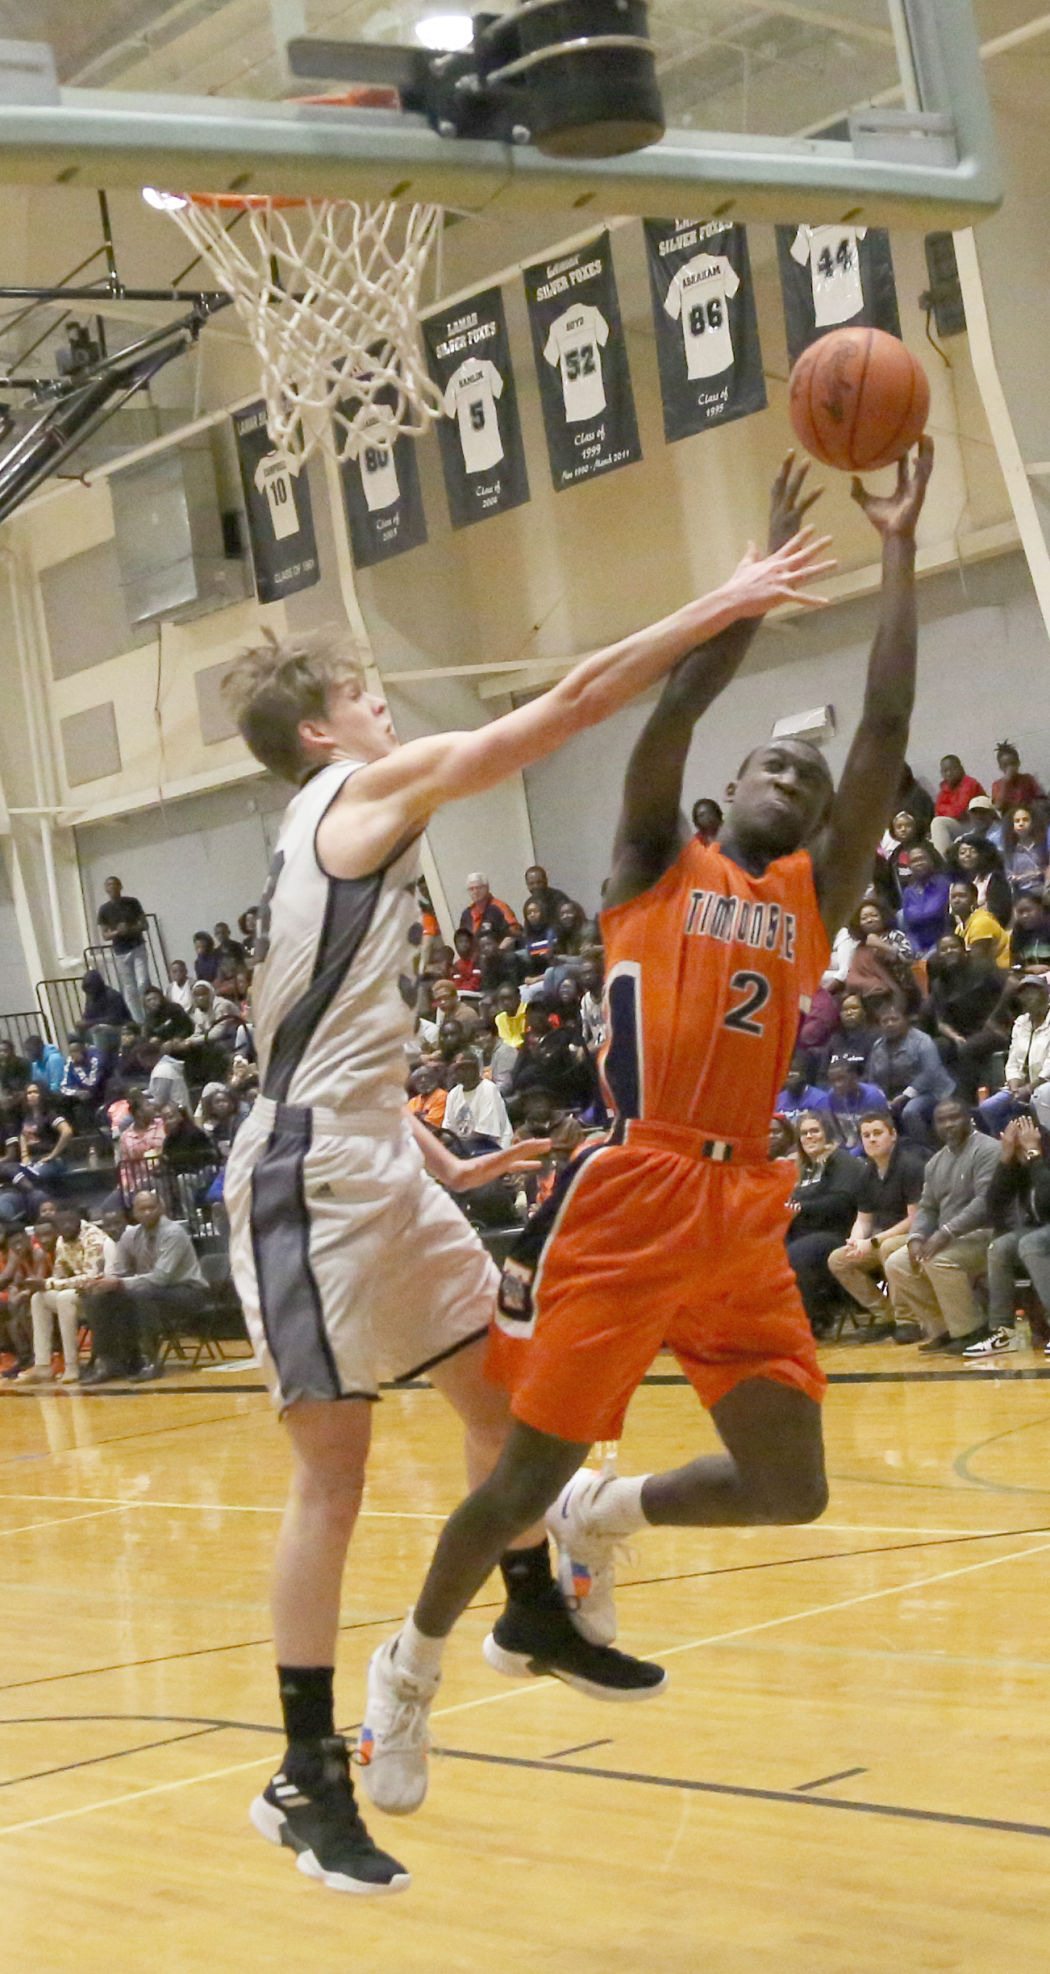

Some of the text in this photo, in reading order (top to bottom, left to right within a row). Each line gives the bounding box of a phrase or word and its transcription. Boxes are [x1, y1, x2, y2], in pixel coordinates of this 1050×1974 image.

[658, 230, 698, 257] SILVER
[699, 219, 734, 241] FOXES
[817, 238, 853, 278] 44
[536, 259, 602, 302] SILVER FOXES
[682, 265, 721, 289] ABRAHAM
[446, 312, 479, 337] LAMAR
[566, 316, 584, 332] BOYD
[689, 298, 723, 336] 86
[436, 321, 496, 360] SILVER FOXES
[564, 344, 597, 381] 52
[698, 386, 729, 405] Class of
[468, 399, 486, 432] 5
[706, 402, 725, 417] 1995
[574, 424, 606, 446] Class of
[582, 443, 602, 460] 1999
[613, 449, 630, 463] 2011
[271, 478, 288, 507] 10
[476, 486, 493, 497] Class
[722, 968, 771, 1038] 2
